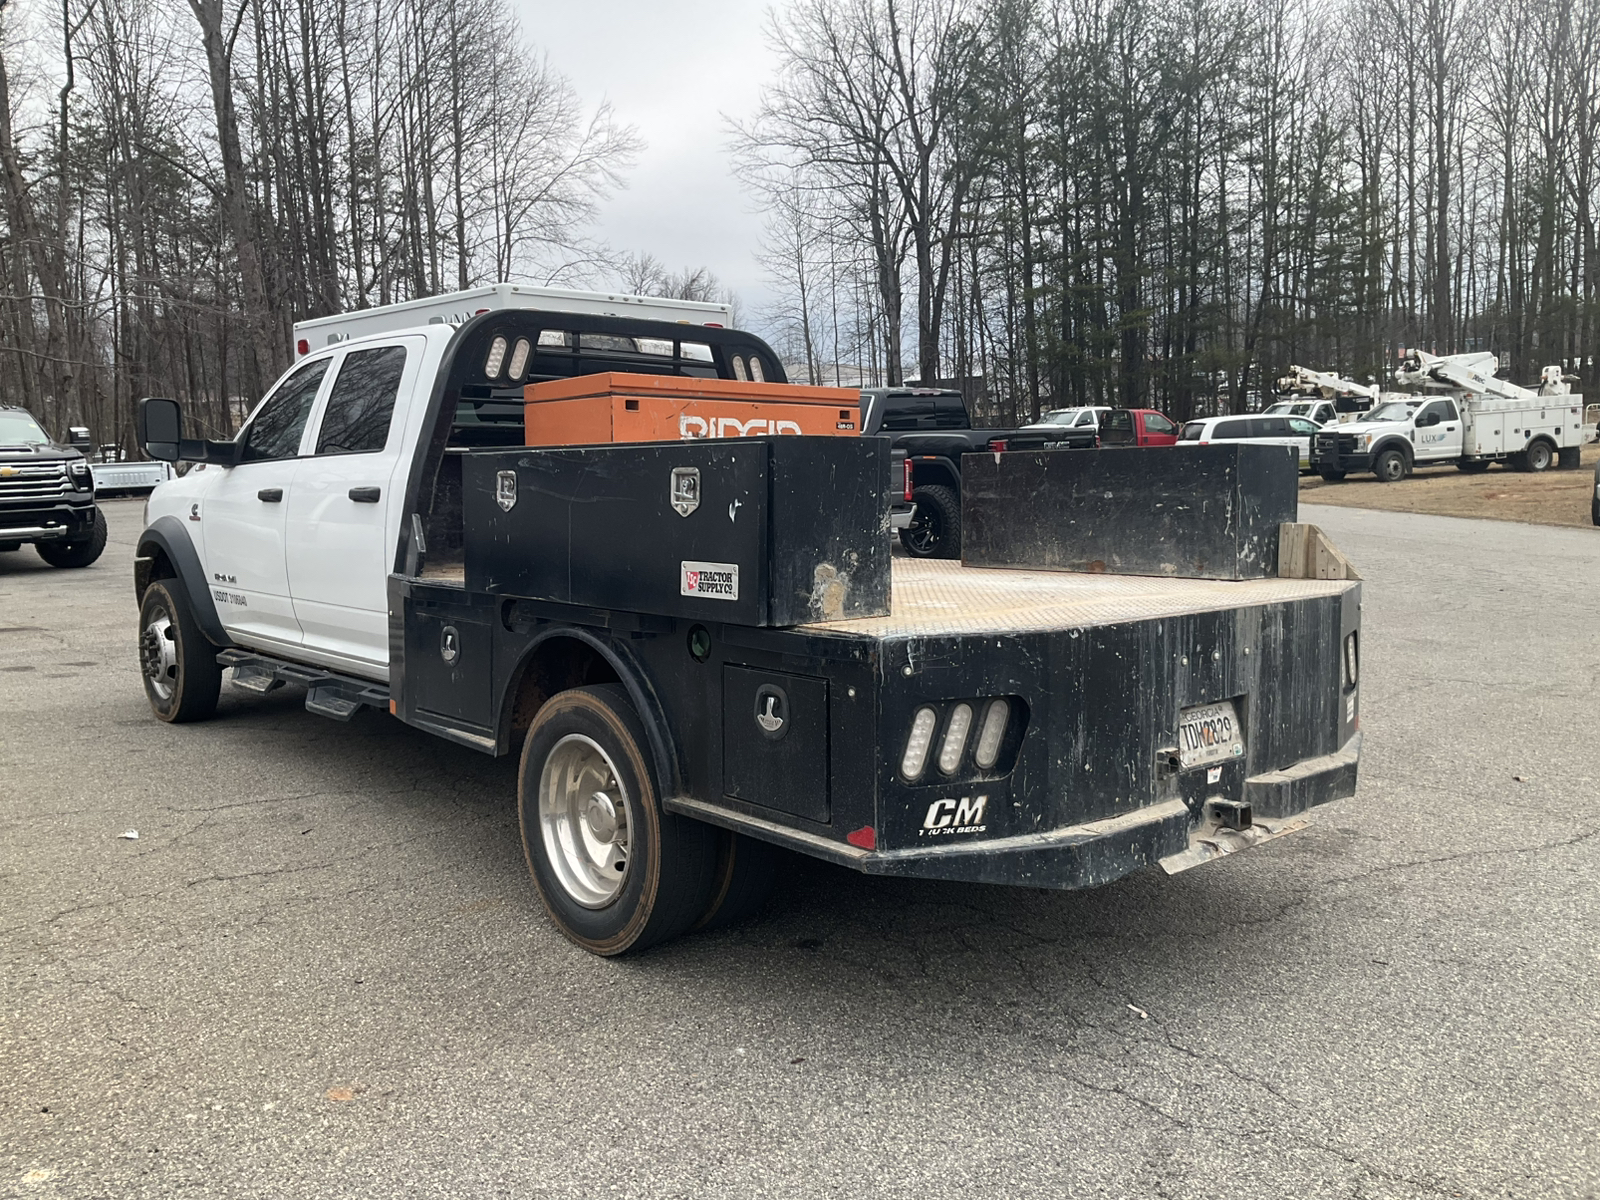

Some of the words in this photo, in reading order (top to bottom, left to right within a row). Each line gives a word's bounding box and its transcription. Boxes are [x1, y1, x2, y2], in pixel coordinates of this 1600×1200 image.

[1421, 434, 1437, 443] LUX
[698, 571, 733, 583] TRACTOR
[698, 582, 724, 594] SUPPLY
[1185, 708, 1220, 722] GEORGIA
[923, 795, 988, 829] CM
[956, 825, 987, 833] BEDS
